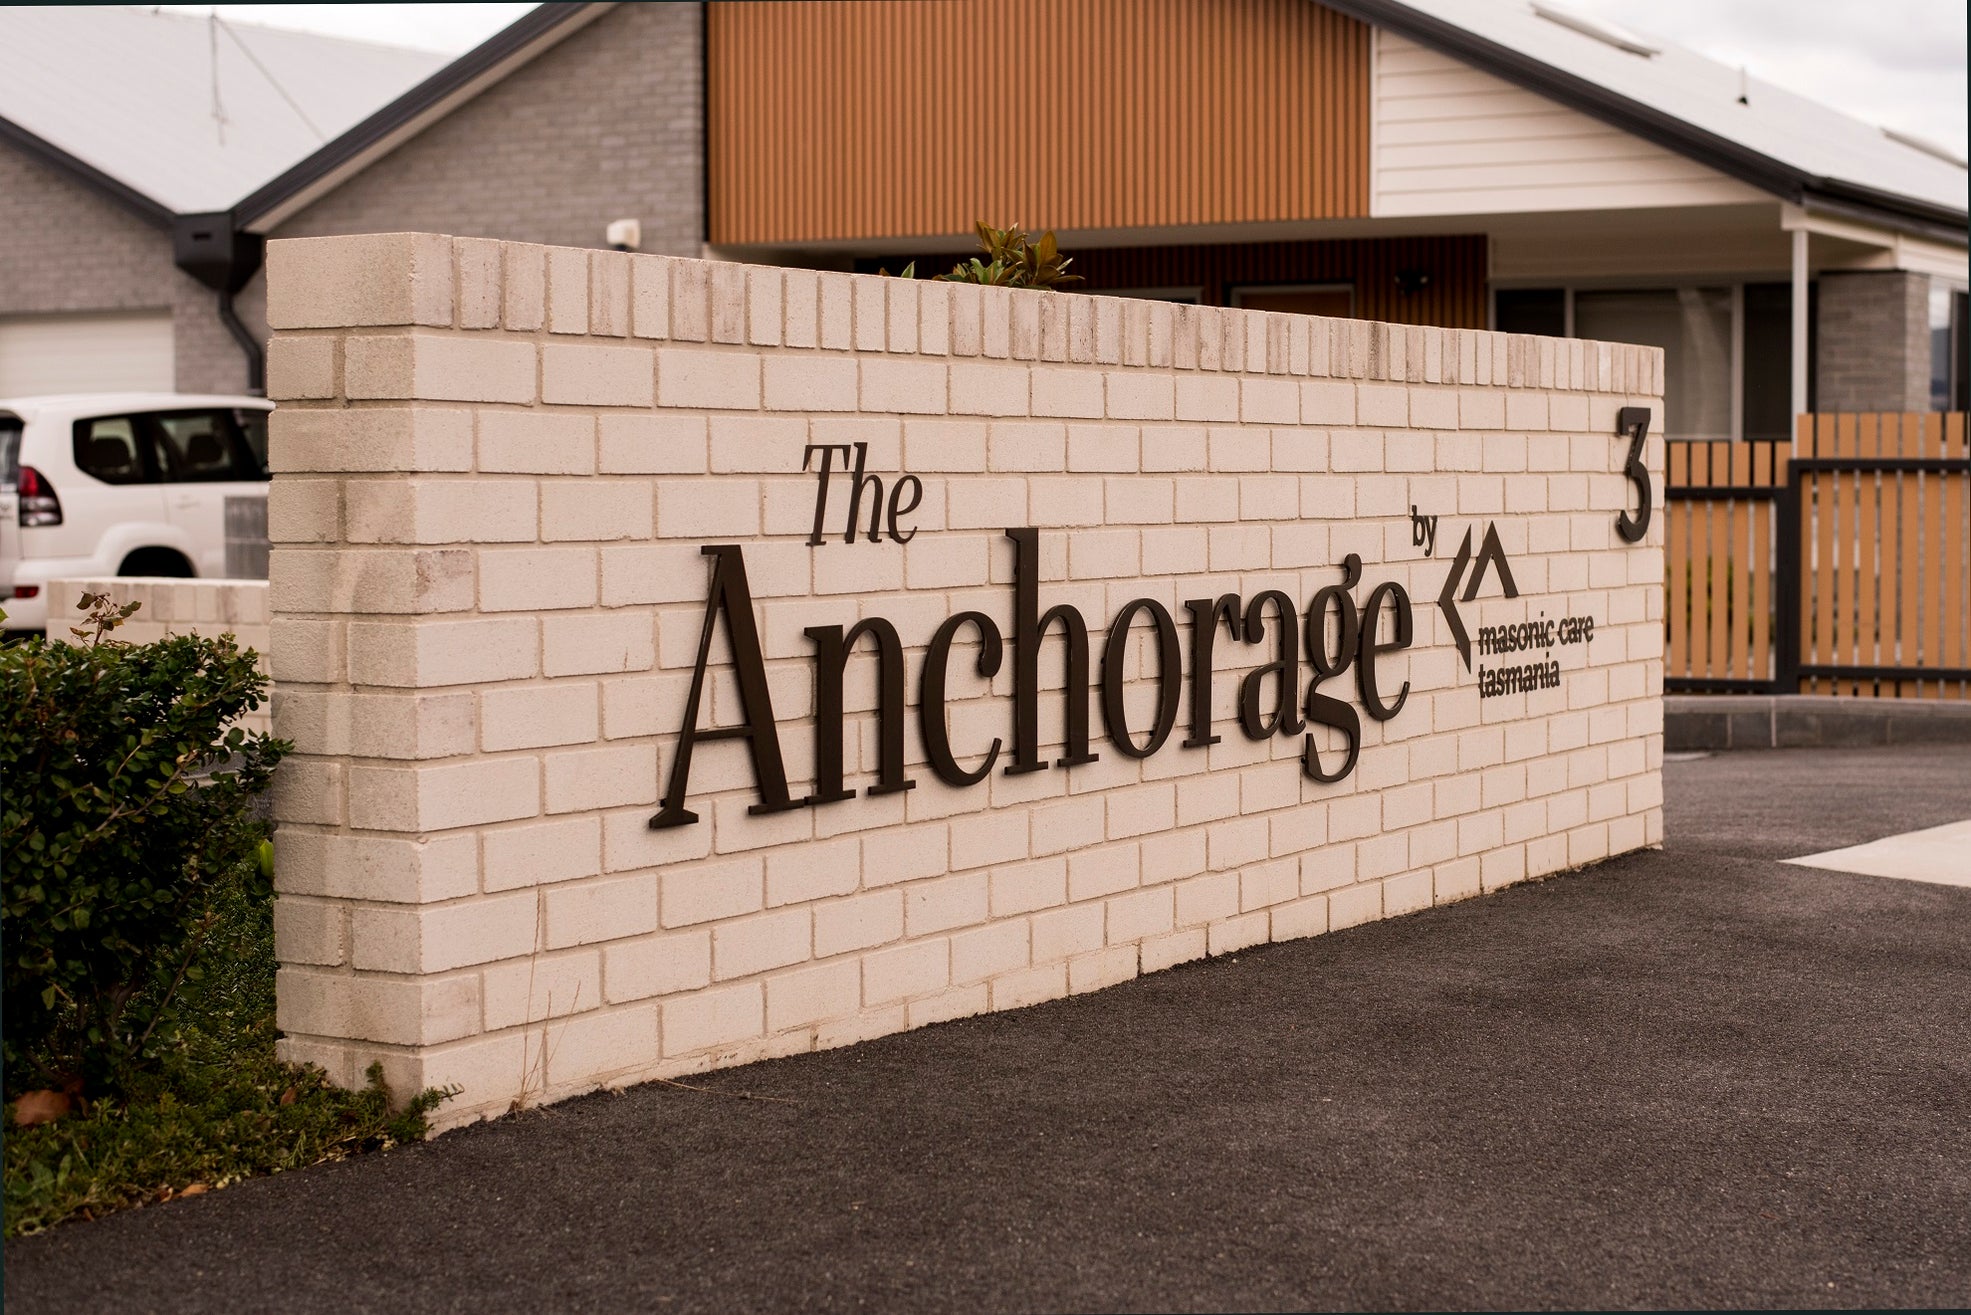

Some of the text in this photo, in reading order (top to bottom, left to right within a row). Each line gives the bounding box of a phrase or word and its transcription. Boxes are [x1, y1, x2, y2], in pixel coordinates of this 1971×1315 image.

[803, 442, 923, 547] The
[1617, 407, 1652, 542] 3
[1411, 505, 1438, 557] by
[1478, 611, 1594, 656] masonic care
[648, 527, 1413, 829] Anchorage
[1478, 651, 1561, 699] tasmania
